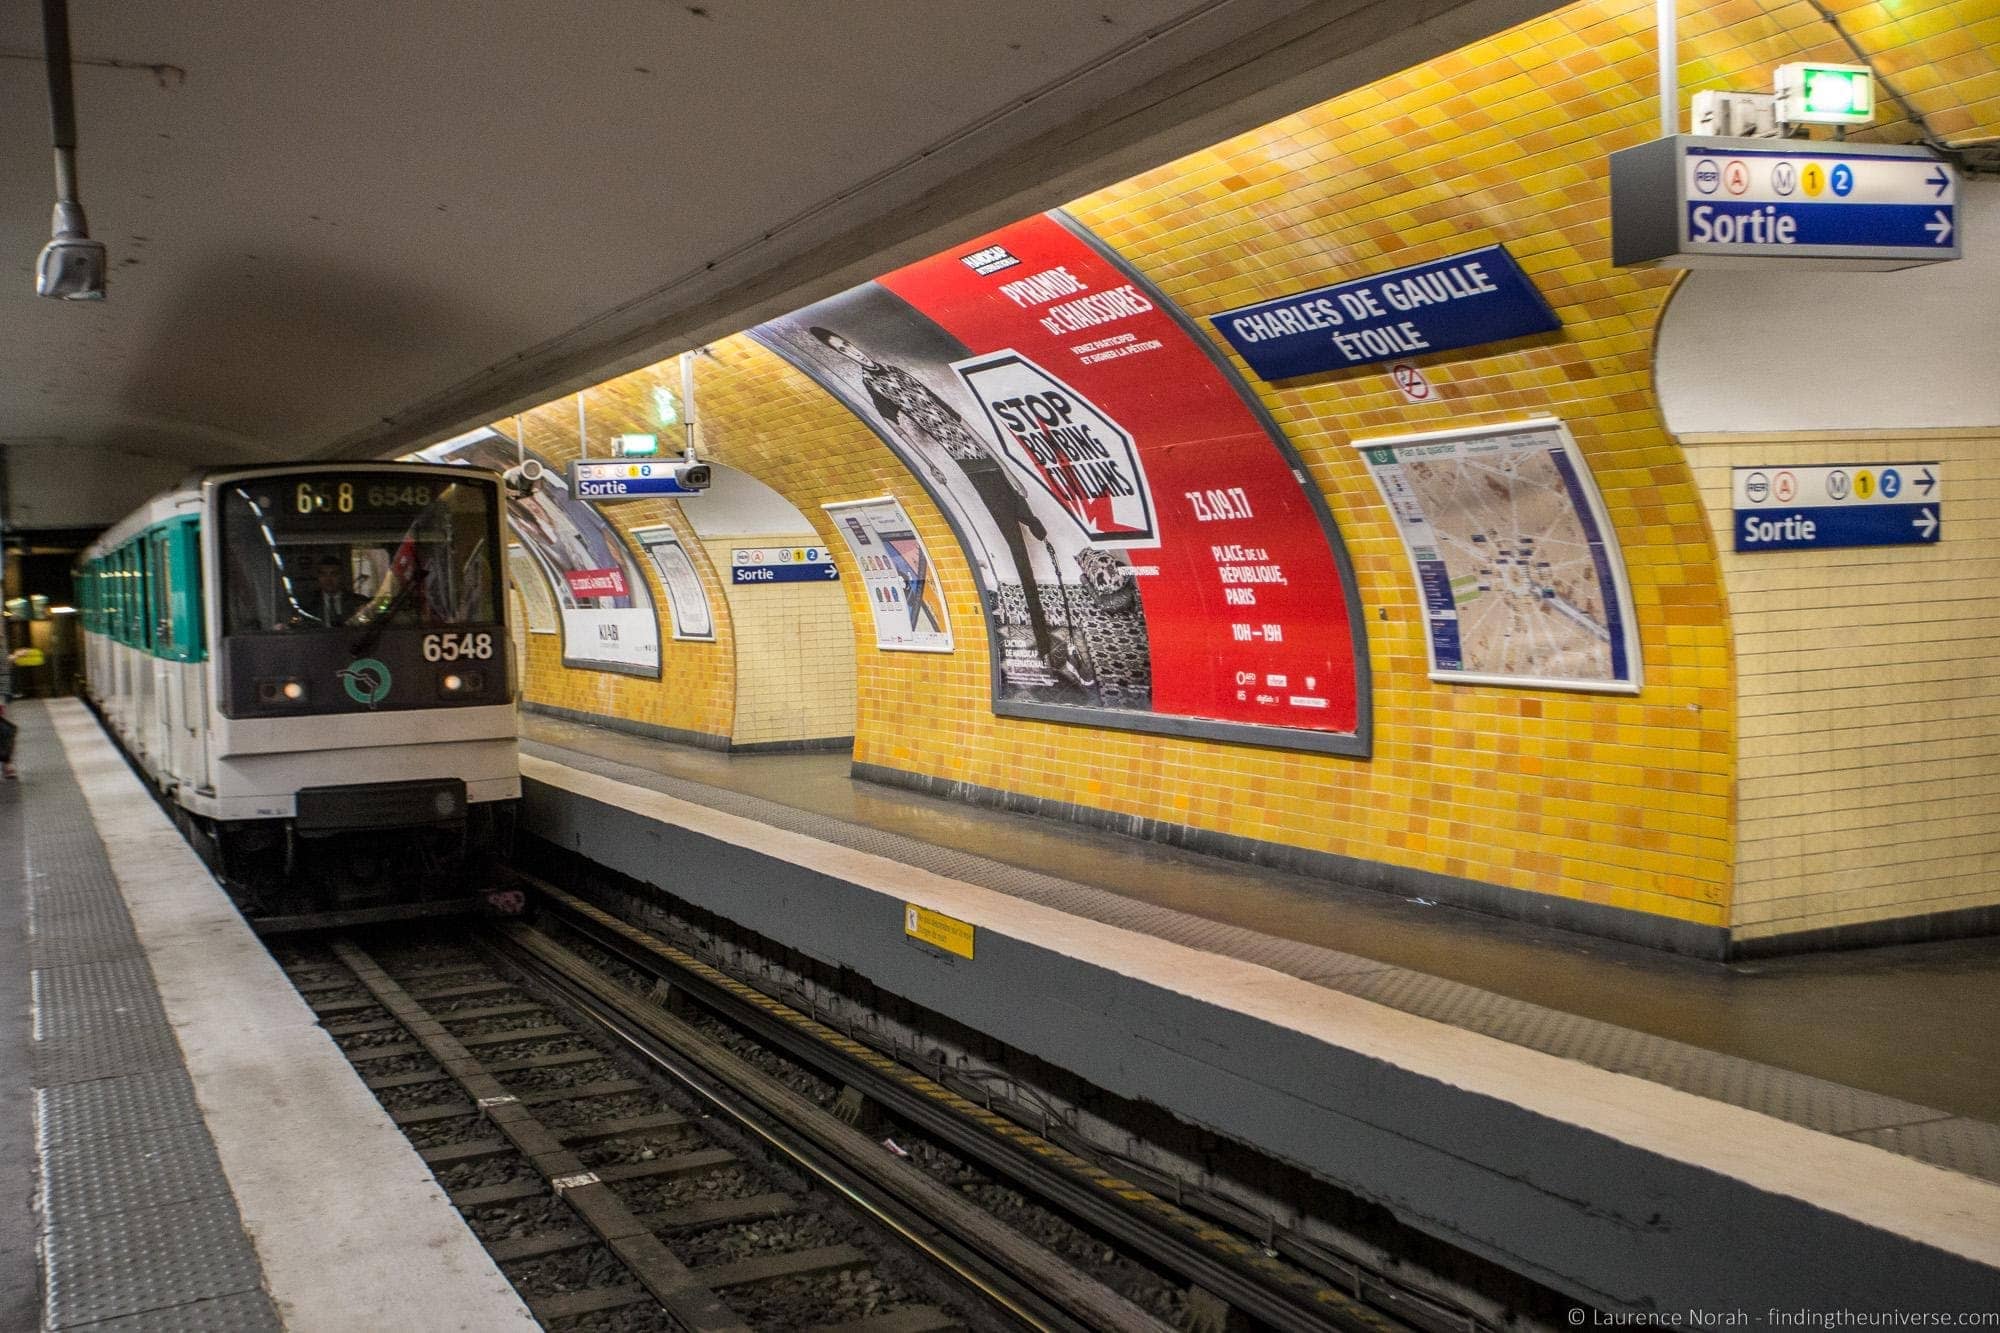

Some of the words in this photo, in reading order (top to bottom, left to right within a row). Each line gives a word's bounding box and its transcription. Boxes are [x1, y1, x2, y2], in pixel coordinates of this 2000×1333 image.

[1835, 169, 1849, 190] 2
[1693, 206, 1796, 244] Sortie
[998, 265, 1089, 309] PYRAMIDE
[1048, 284, 1154, 332] CHAUSSURES
[1232, 298, 1344, 344] CHARLES
[1338, 288, 1387, 322] DE
[1381, 262, 1498, 312] GAULLE
[1039, 317, 1067, 336] DE
[1331, 321, 1431, 361] ÉTOILE
[991, 390, 1075, 433] STOP
[1018, 424, 1110, 466] BOMBING
[580, 480, 627, 494] Sortie
[1045, 460, 1135, 503] CIVILIANS
[1744, 514, 1816, 542] Sortie
[1211, 545, 1244, 562] PLACE
[1244, 548, 1257, 561] DE
[1256, 548, 1269, 561] LA
[736, 568, 774, 581] Sortie
[1219, 563, 1288, 586] RÉPUBLIQUE,
[1225, 588, 1257, 605] PARIS
[422, 633, 493, 662] 6548
